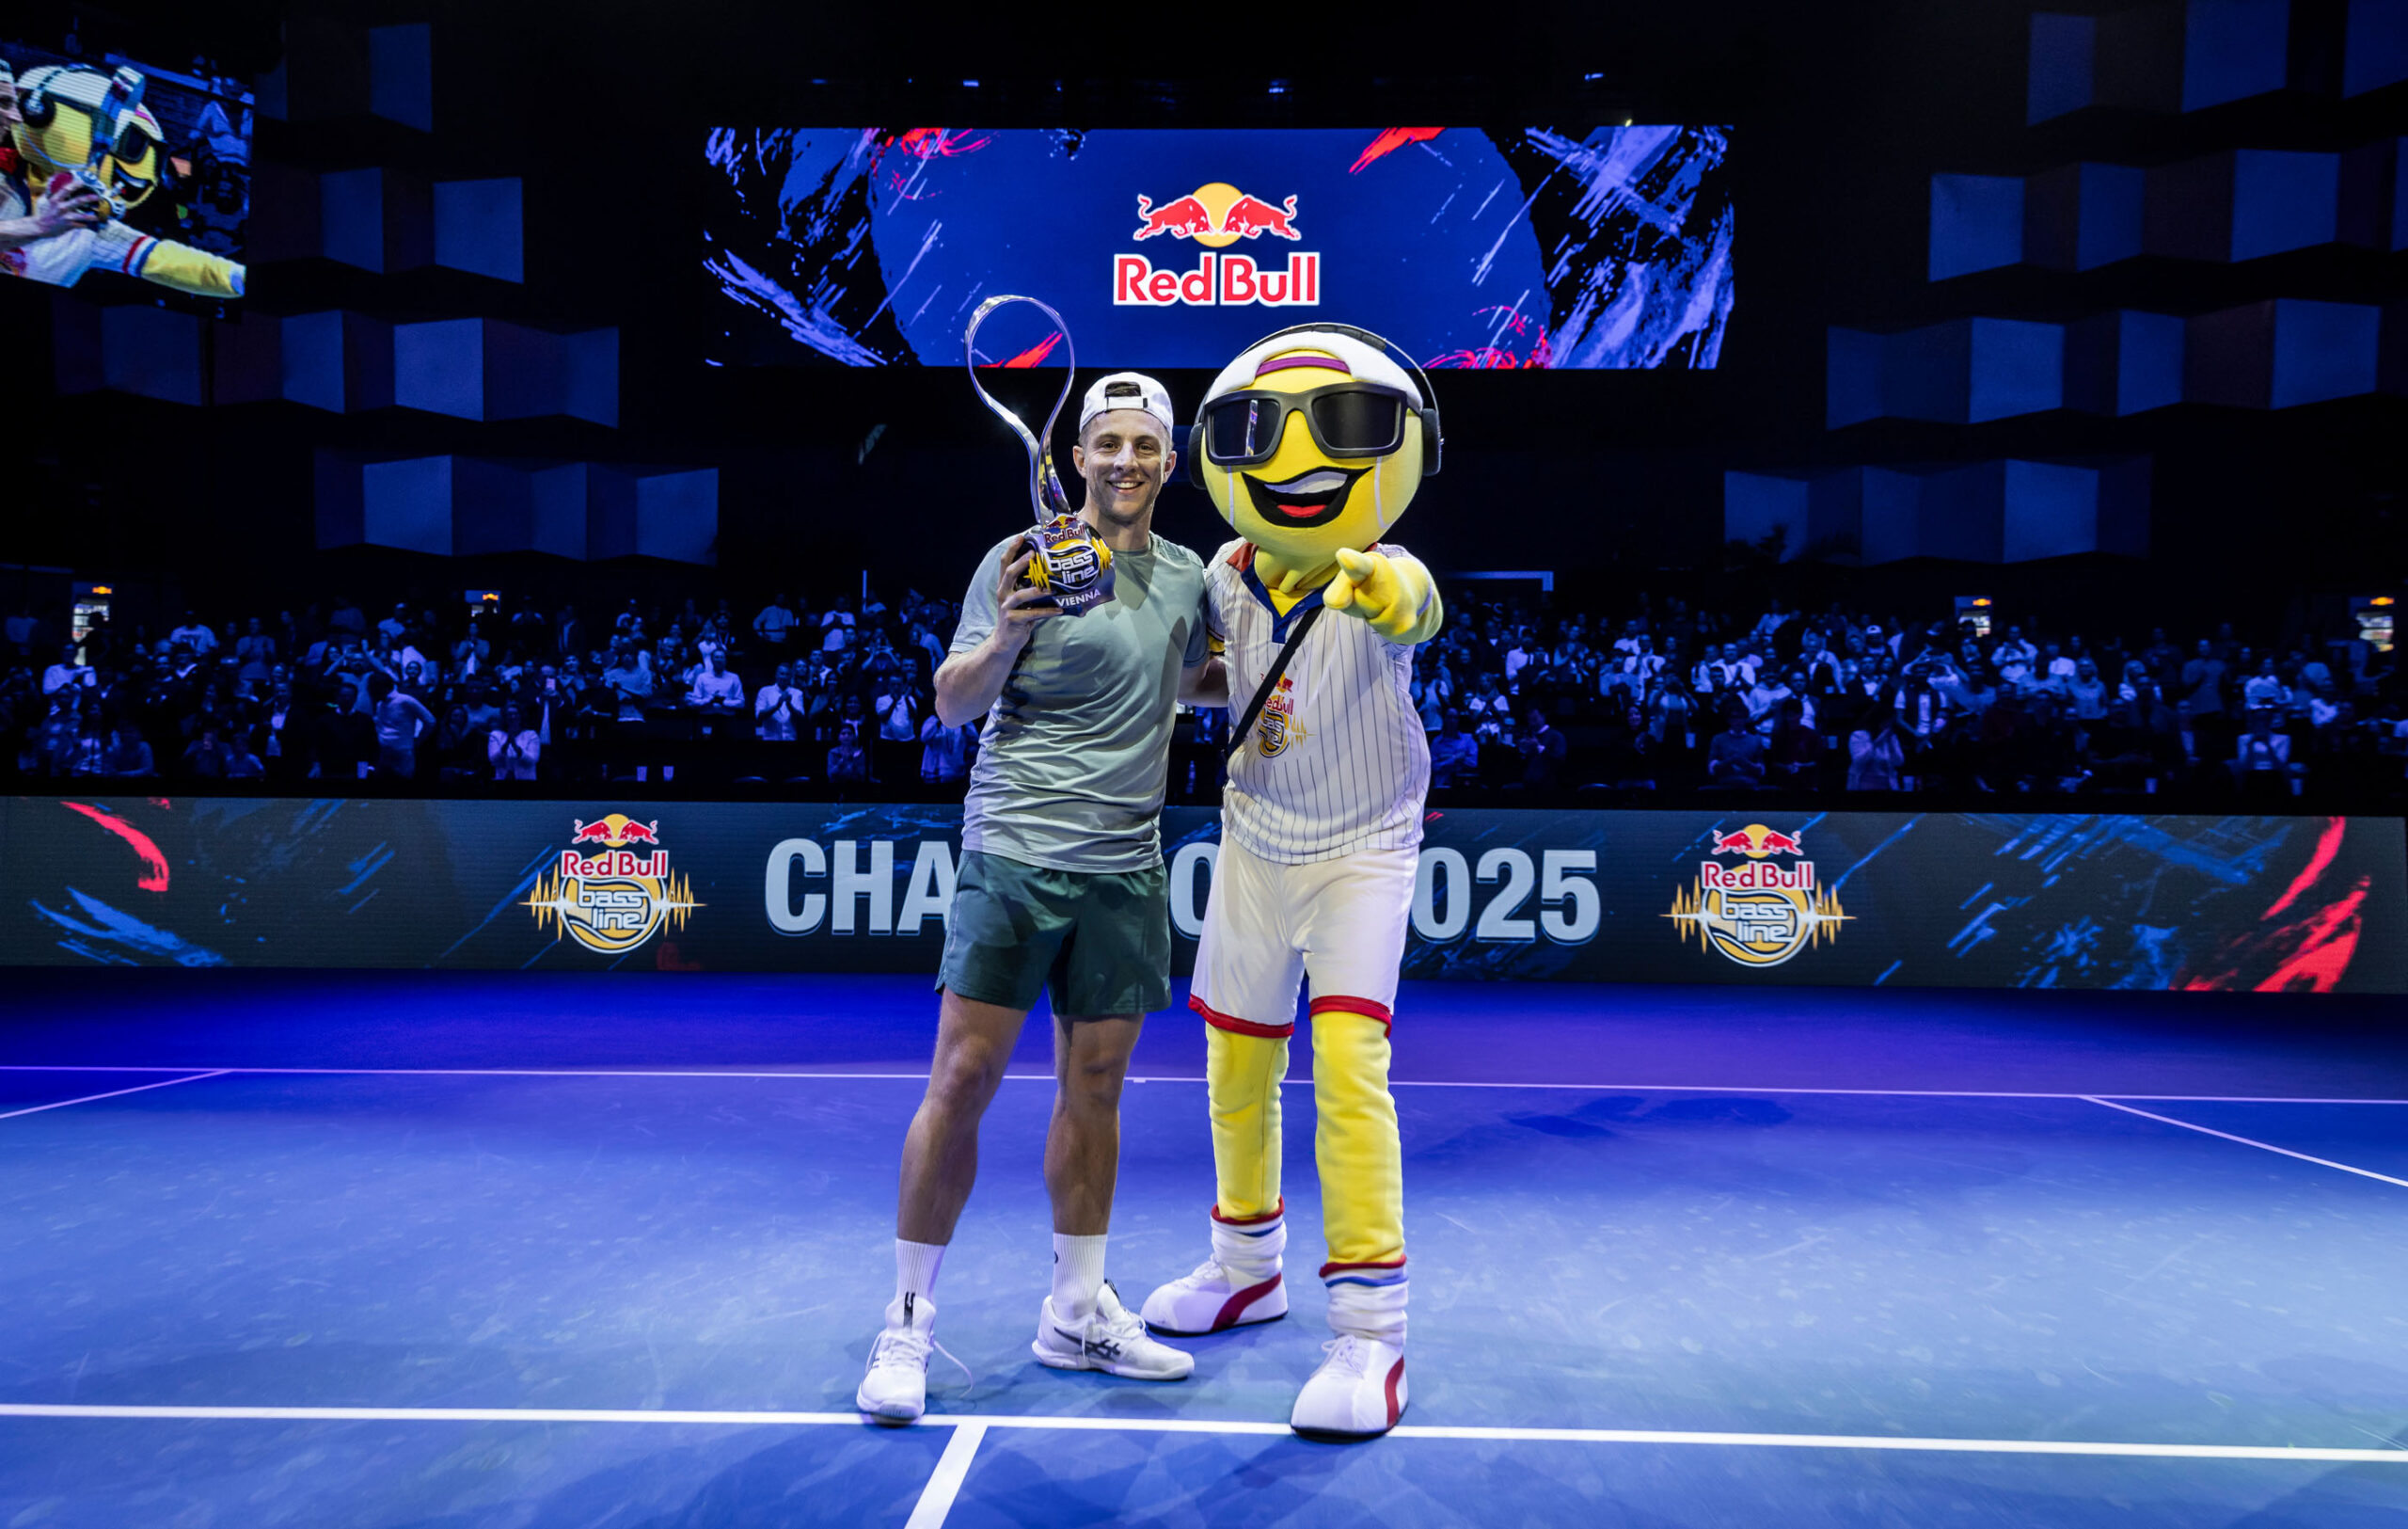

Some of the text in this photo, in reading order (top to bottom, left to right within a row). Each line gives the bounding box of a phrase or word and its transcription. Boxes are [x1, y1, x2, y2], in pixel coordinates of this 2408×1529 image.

[1115, 253, 1318, 304] Red Bull
[1044, 523, 1085, 544] Red Bull
[1047, 552, 1094, 572] bass
[1061, 565, 1097, 584] line
[1055, 588, 1101, 607] VIENNA
[562, 851, 668, 878] Red Bull
[1703, 862, 1813, 888] Red Bull
[578, 879, 645, 908] bass
[1411, 846, 1602, 945] 025
[1720, 890, 1791, 920] bass
[591, 907, 644, 930] line
[1736, 920, 1790, 942] line
